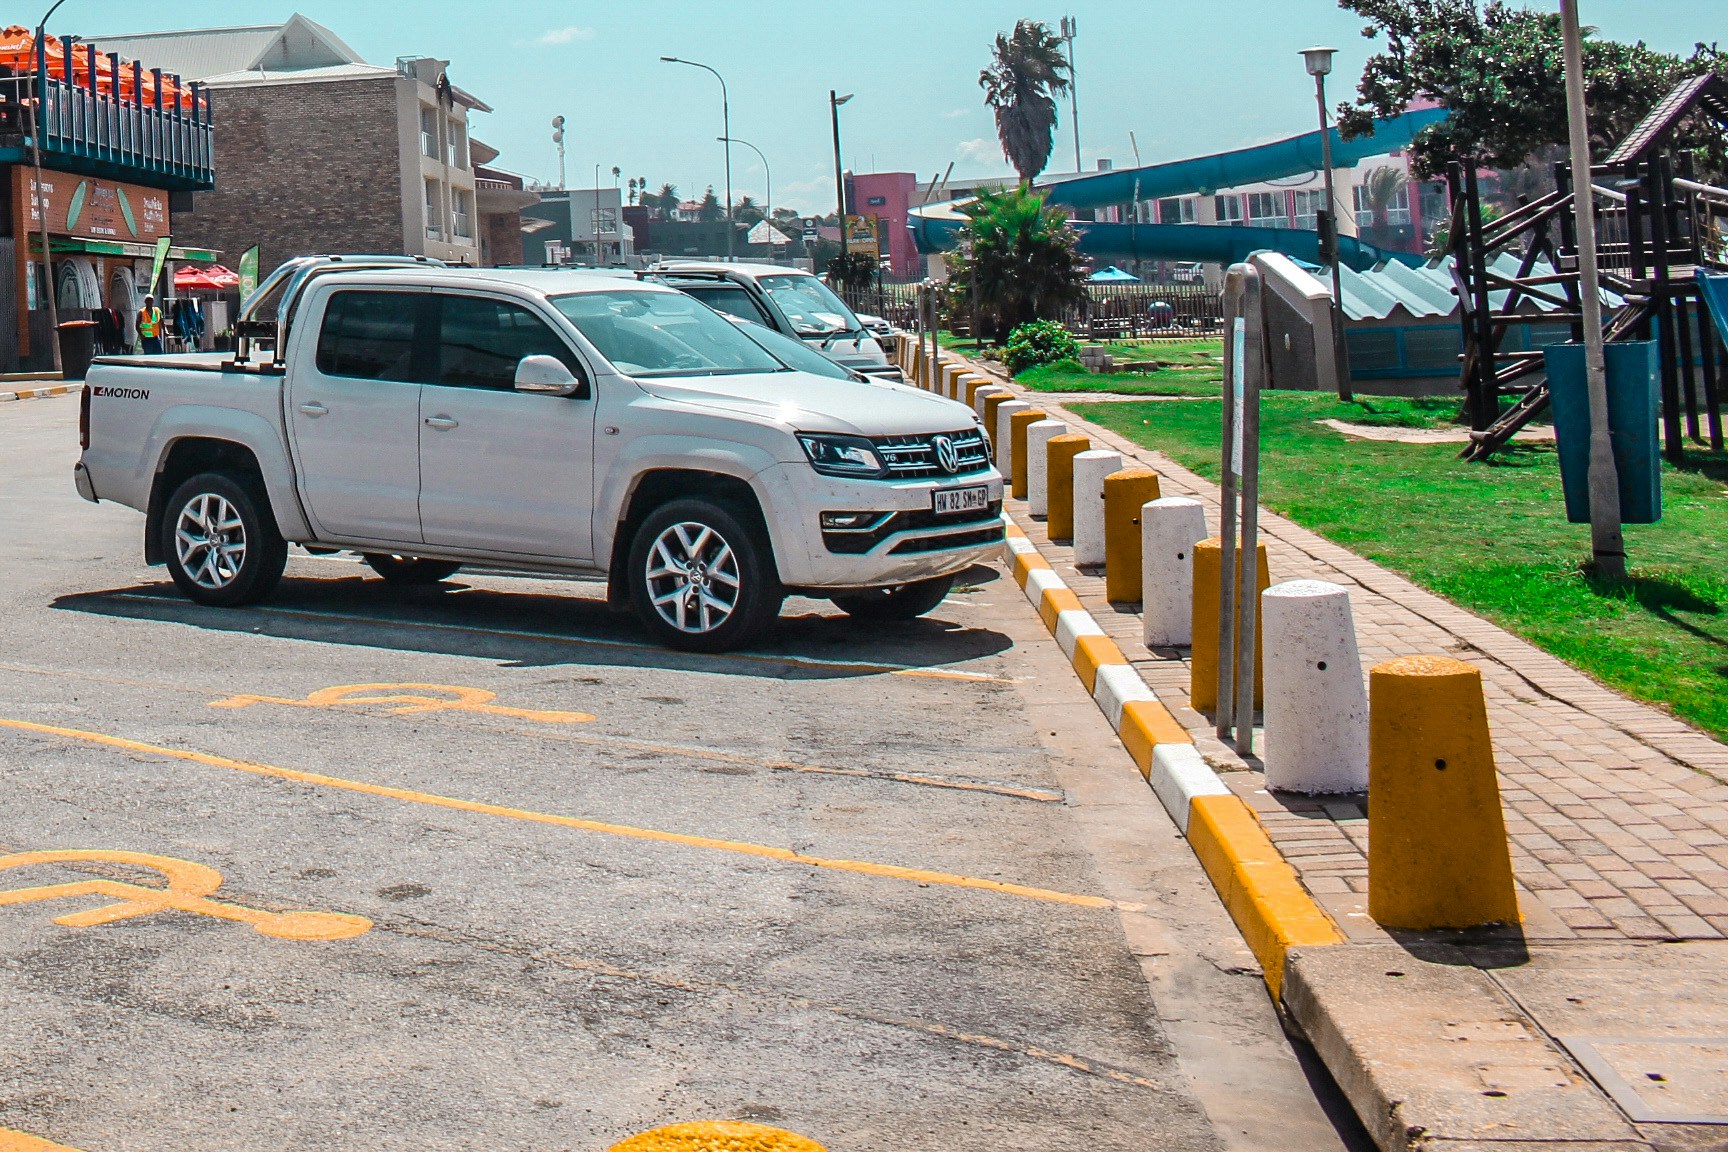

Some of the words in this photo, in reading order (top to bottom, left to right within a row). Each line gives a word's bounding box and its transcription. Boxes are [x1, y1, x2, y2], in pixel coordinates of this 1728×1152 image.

[883, 453, 897, 462] V6
[937, 493, 947, 511] HW
[950, 491, 960, 510] 82
[977, 488, 986, 506] GP
